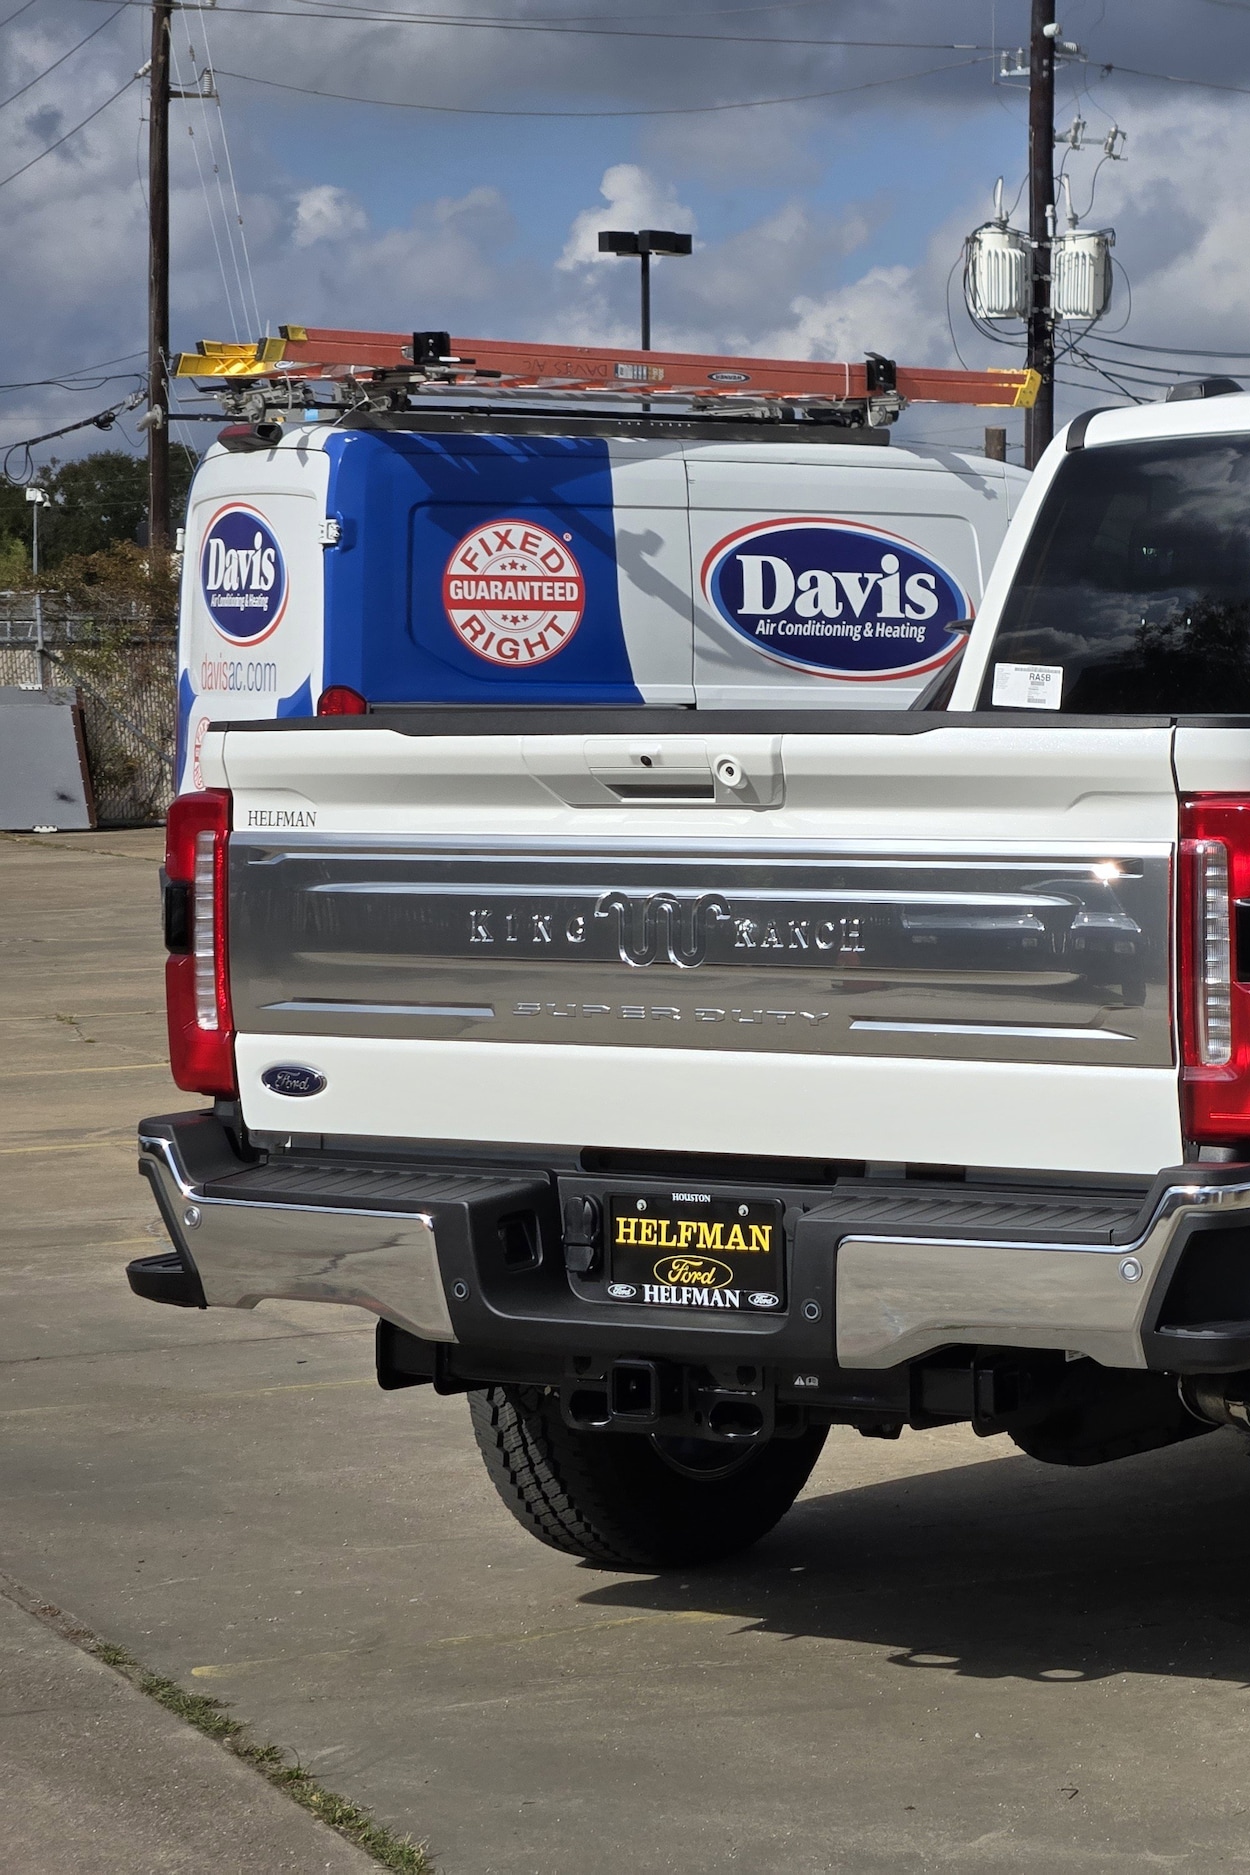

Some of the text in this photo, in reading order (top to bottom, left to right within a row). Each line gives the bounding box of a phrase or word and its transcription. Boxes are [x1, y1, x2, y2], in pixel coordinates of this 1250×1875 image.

[206, 531, 275, 591] Davis
[460, 528, 565, 573] FIXED
[450, 580, 579, 602] GUARANTEED
[736, 553, 939, 620] Davis
[460, 614, 566, 660] RIGHT
[755, 619, 926, 643] Air Conditioning & Heating
[201, 653, 277, 692] davisac.com
[247, 810, 317, 827] HELFMAN
[469, 909, 866, 952] KING RANCH
[512, 1002, 830, 1026] SUPER DUTY
[672, 1193, 711, 1203] HOUSTON
[615, 1217, 773, 1252] HELFMAN
[668, 1258, 716, 1285] Ford
[642, 1284, 741, 1308] HELFMAN
